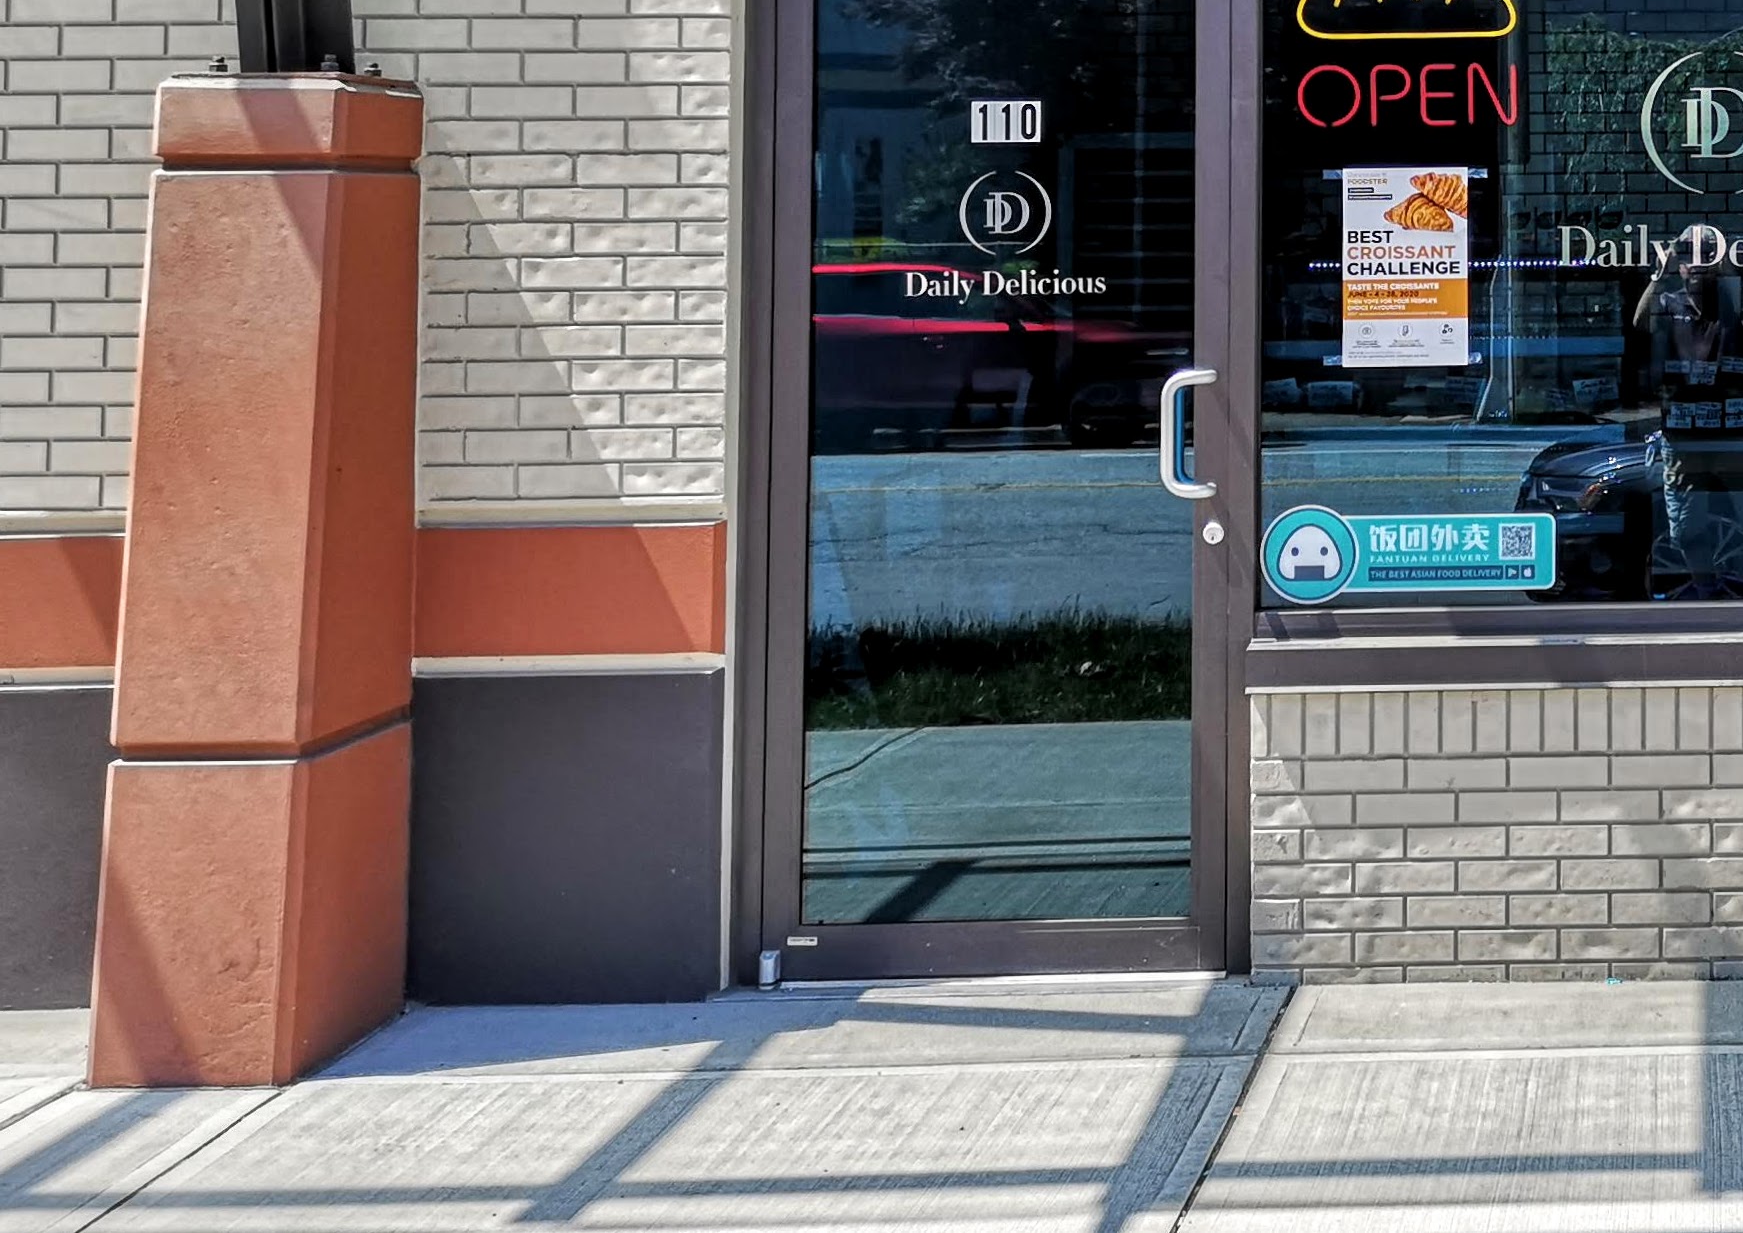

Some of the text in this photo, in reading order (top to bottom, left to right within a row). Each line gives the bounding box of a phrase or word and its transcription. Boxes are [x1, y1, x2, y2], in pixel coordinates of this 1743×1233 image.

[1297, 63, 1518, 127] OPEN
[977, 103, 1037, 141] 110
[1347, 231, 1394, 244] BEST
[1347, 245, 1456, 260] CROISSANT
[1556, 223, 1677, 282] Daily
[1347, 261, 1461, 275] CHALLENGE
[904, 268, 1107, 305] Daily Delicious
[1369, 523, 1490, 552] 饭团外卖
[1369, 553, 1490, 564] FANTUAN DELIVERY
[1370, 568, 1502, 579] THE BEST ASIAN FOOD DELIVERY
